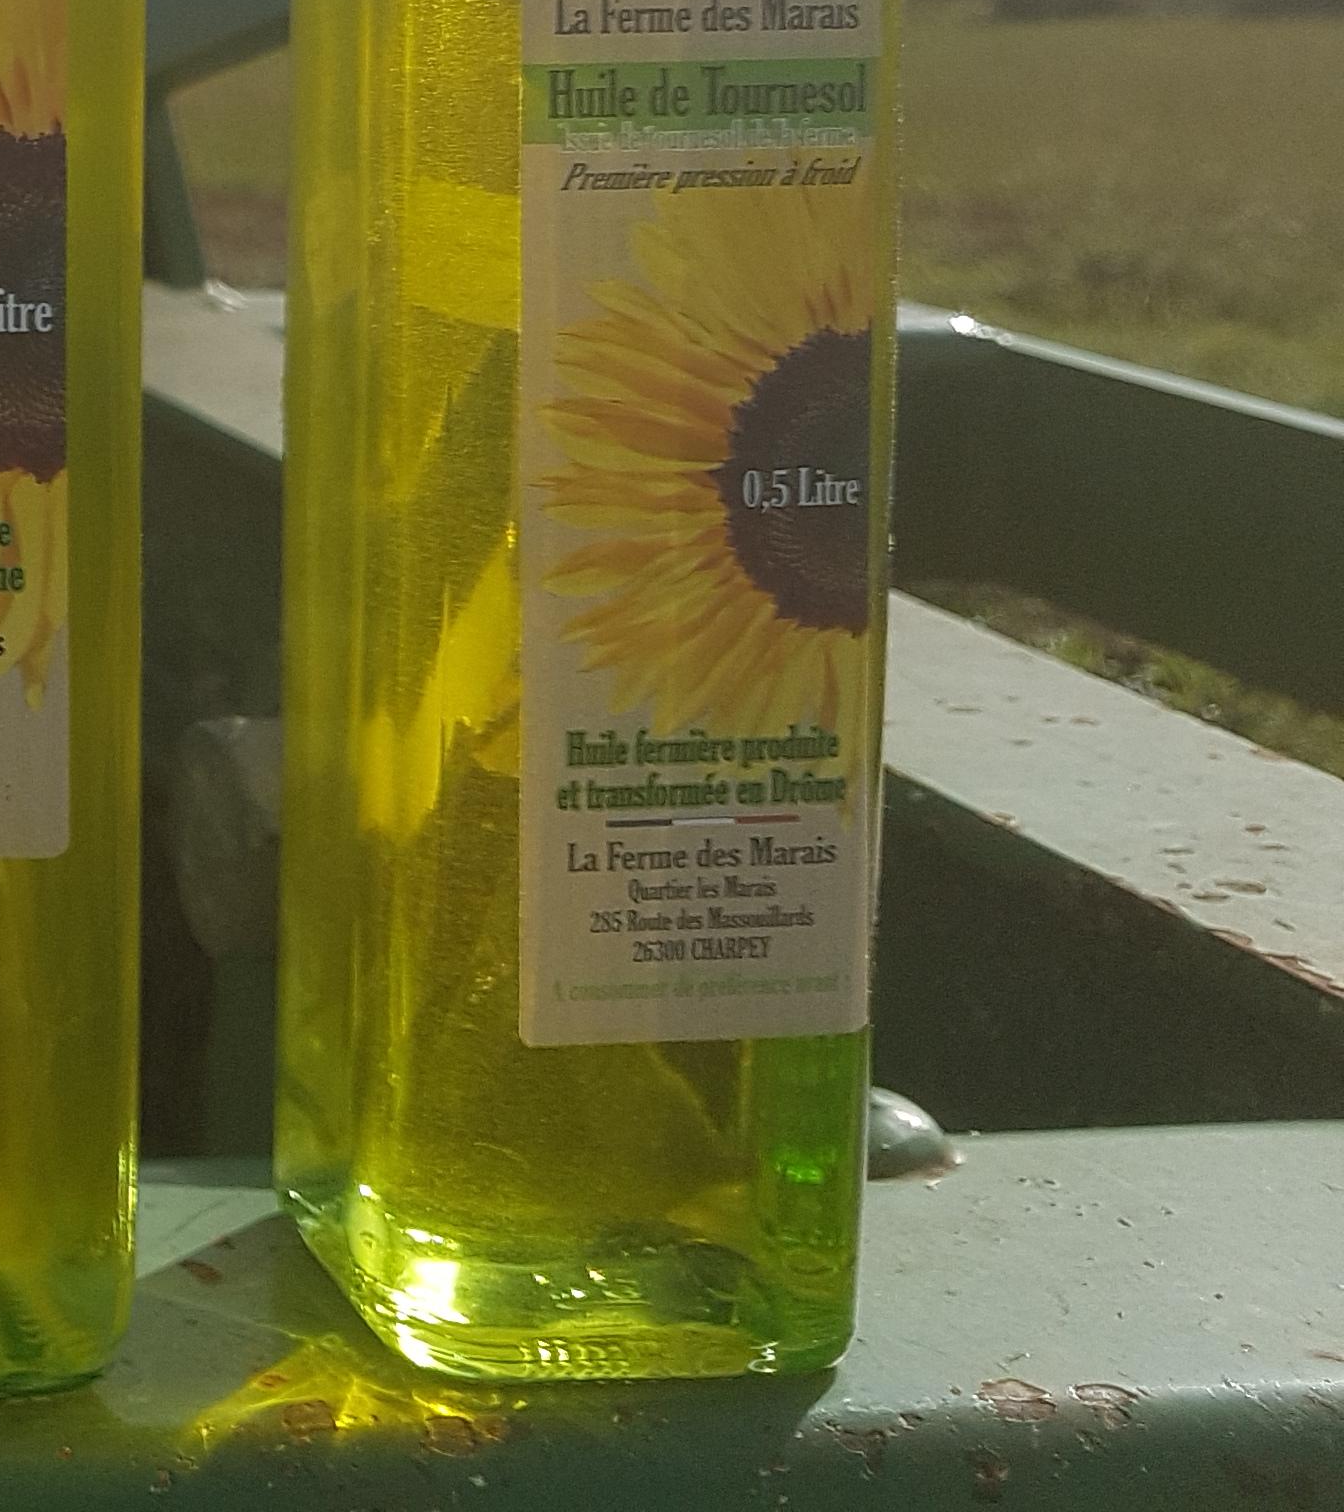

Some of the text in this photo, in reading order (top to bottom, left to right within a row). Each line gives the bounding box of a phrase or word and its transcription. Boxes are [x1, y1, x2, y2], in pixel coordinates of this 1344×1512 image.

[548, 64, 867, 119] Huile de Tournesol
[561, 156, 861, 193] Première pression à froid
[742, 467, 860, 513] 0,5 Litre
[567, 836, 838, 872] La Ferme des Marais
[633, 936, 771, 962] 26300 CHARPEY
